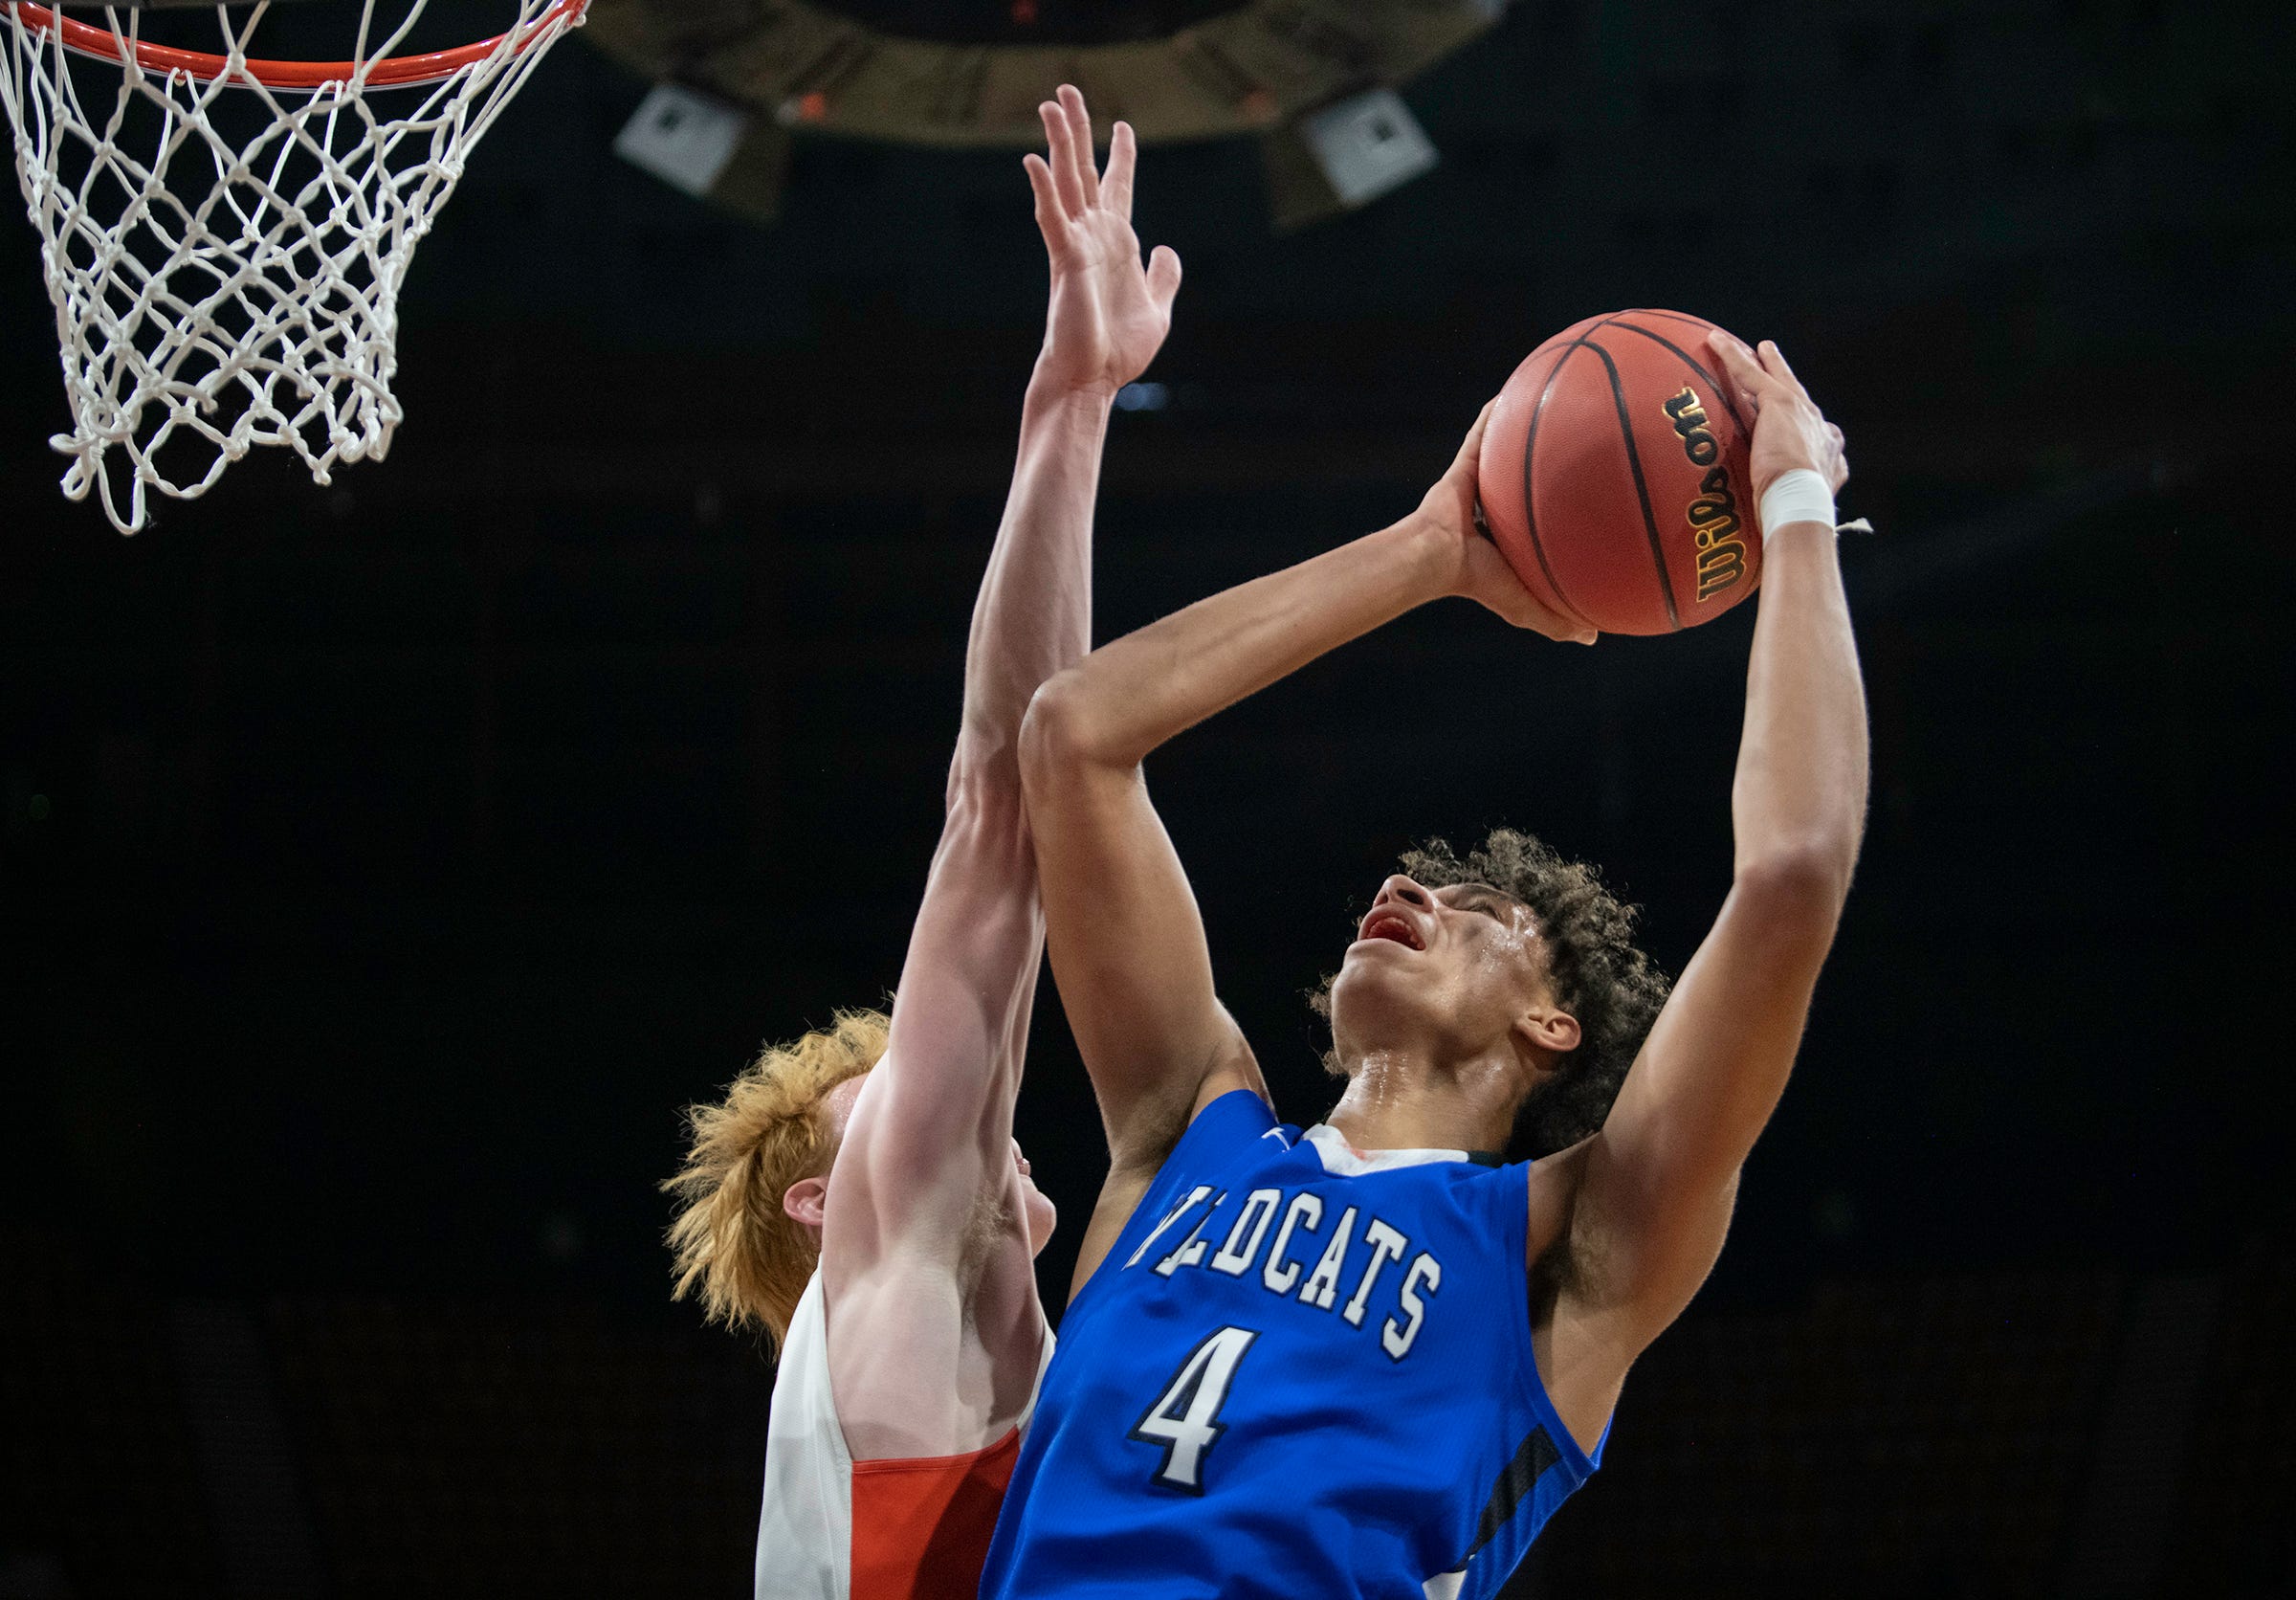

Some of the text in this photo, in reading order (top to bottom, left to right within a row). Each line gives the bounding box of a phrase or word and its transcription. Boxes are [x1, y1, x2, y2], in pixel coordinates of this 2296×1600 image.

[1662, 387, 1747, 603] Wilson
[1121, 1184, 1443, 1363] LDCATS
[1128, 1324, 1261, 1496] 4
